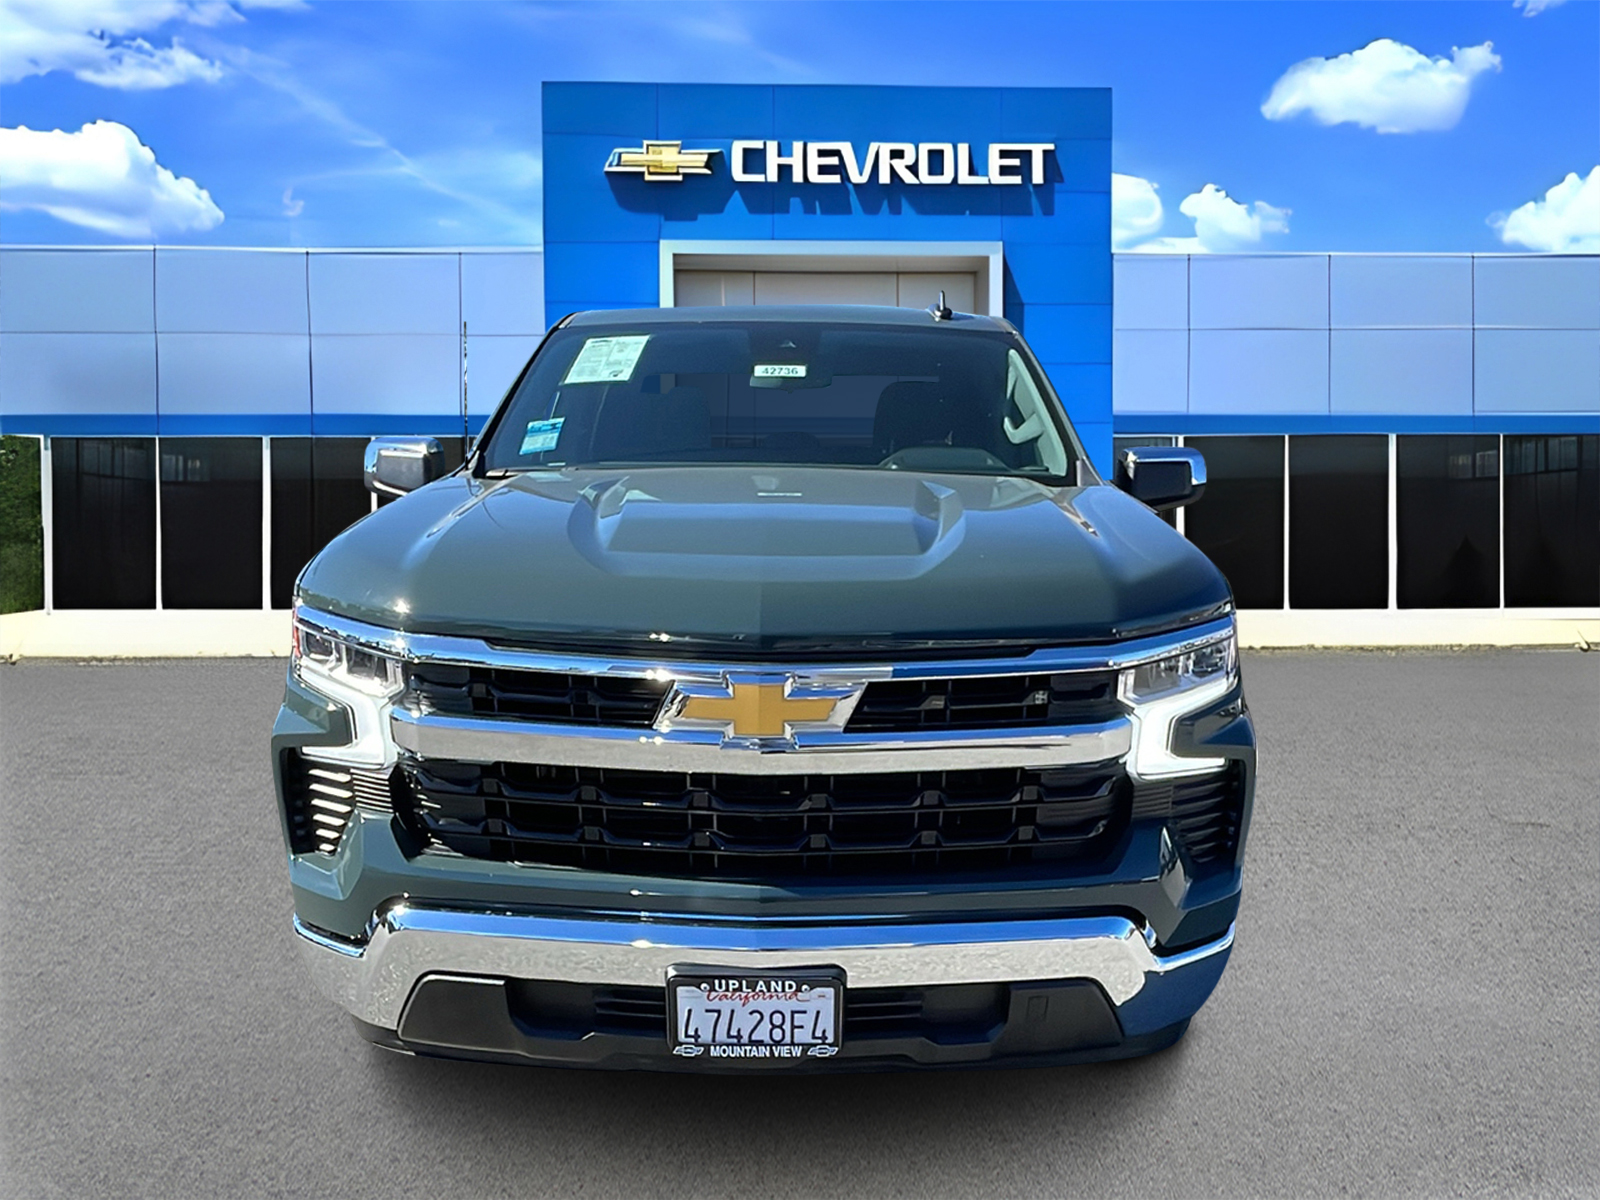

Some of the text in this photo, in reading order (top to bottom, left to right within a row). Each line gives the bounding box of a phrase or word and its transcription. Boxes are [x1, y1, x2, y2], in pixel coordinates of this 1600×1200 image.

[731, 140, 1055, 184] CHEVROLET
[761, 366, 799, 376] 42736
[714, 979, 797, 993] UPLAND
[684, 1008, 828, 1043] 47428F4
[710, 1045, 802, 1057] MOUNTAIN VIEW
